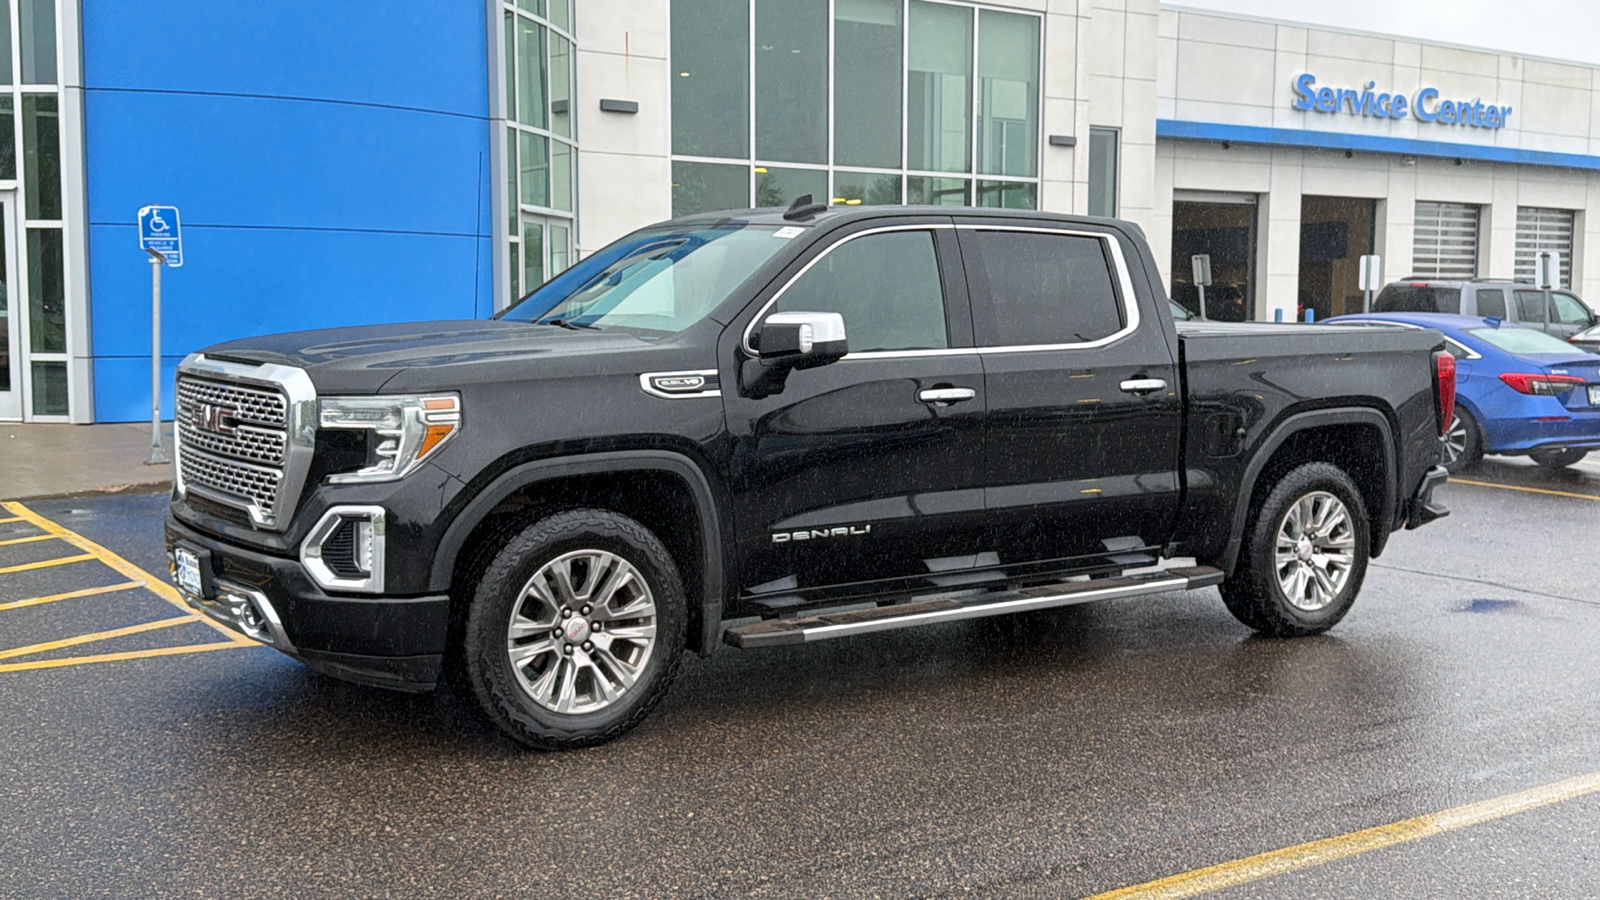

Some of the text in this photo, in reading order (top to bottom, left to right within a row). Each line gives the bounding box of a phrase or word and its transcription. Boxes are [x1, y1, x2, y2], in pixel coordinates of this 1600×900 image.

[1292, 73, 1512, 129] Service Center
[191, 403, 238, 435] GMC
[772, 525, 871, 543] DENALI
